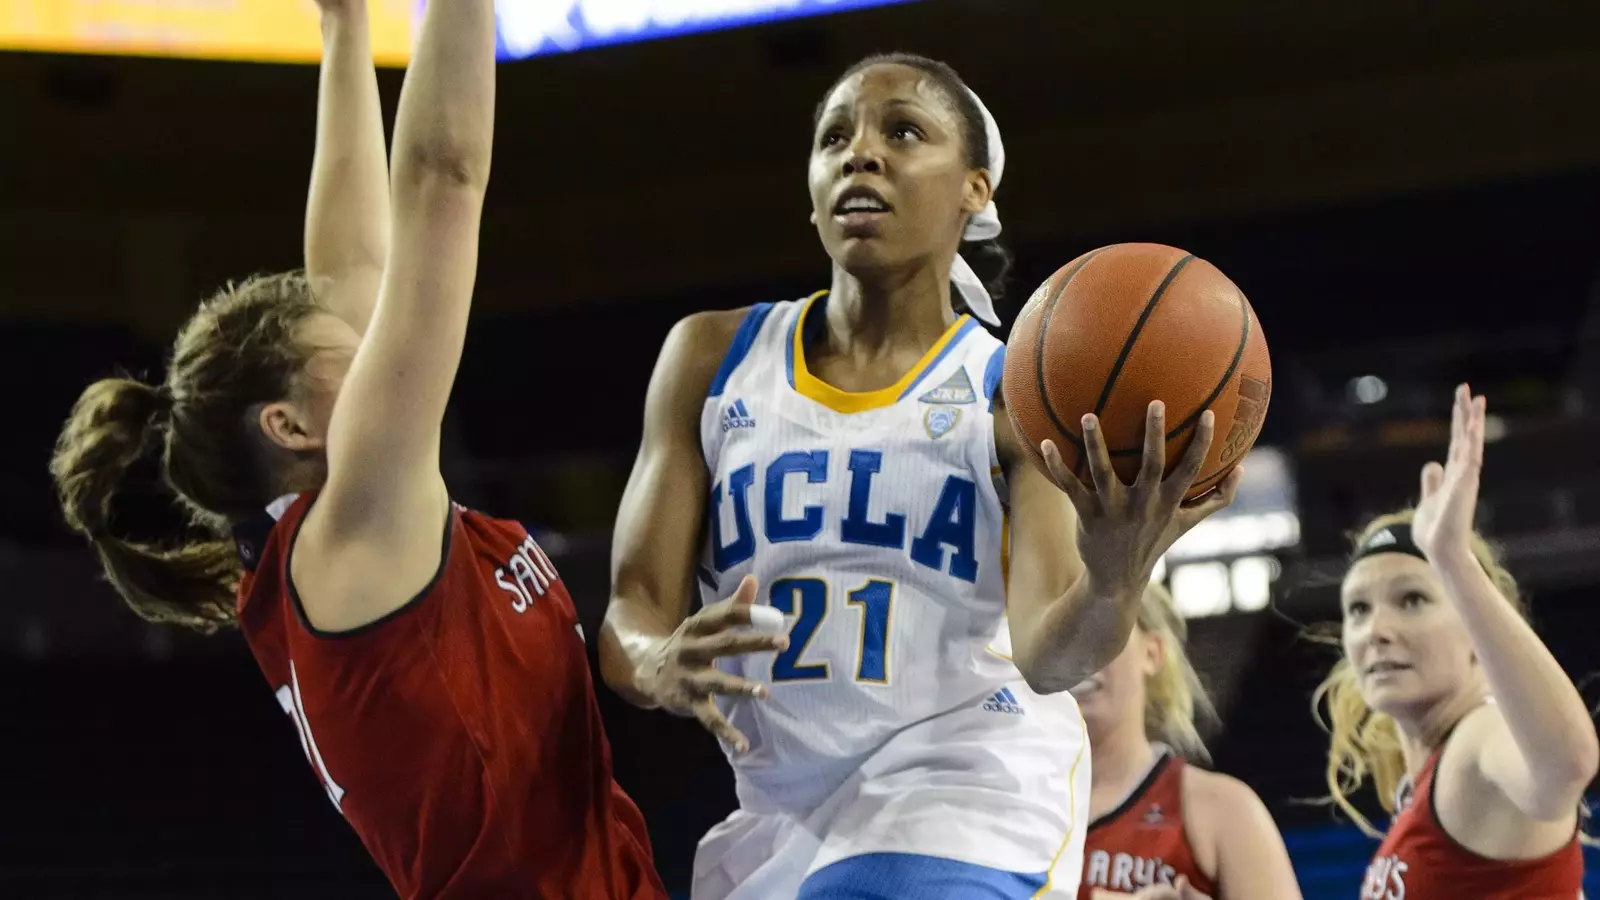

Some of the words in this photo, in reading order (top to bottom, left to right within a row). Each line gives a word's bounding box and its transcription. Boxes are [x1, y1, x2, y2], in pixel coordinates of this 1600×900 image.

[722, 418, 756, 433] adidas
[711, 449, 979, 584] UCLA
[768, 576, 896, 686] 21
[983, 702, 1025, 716] adidas
